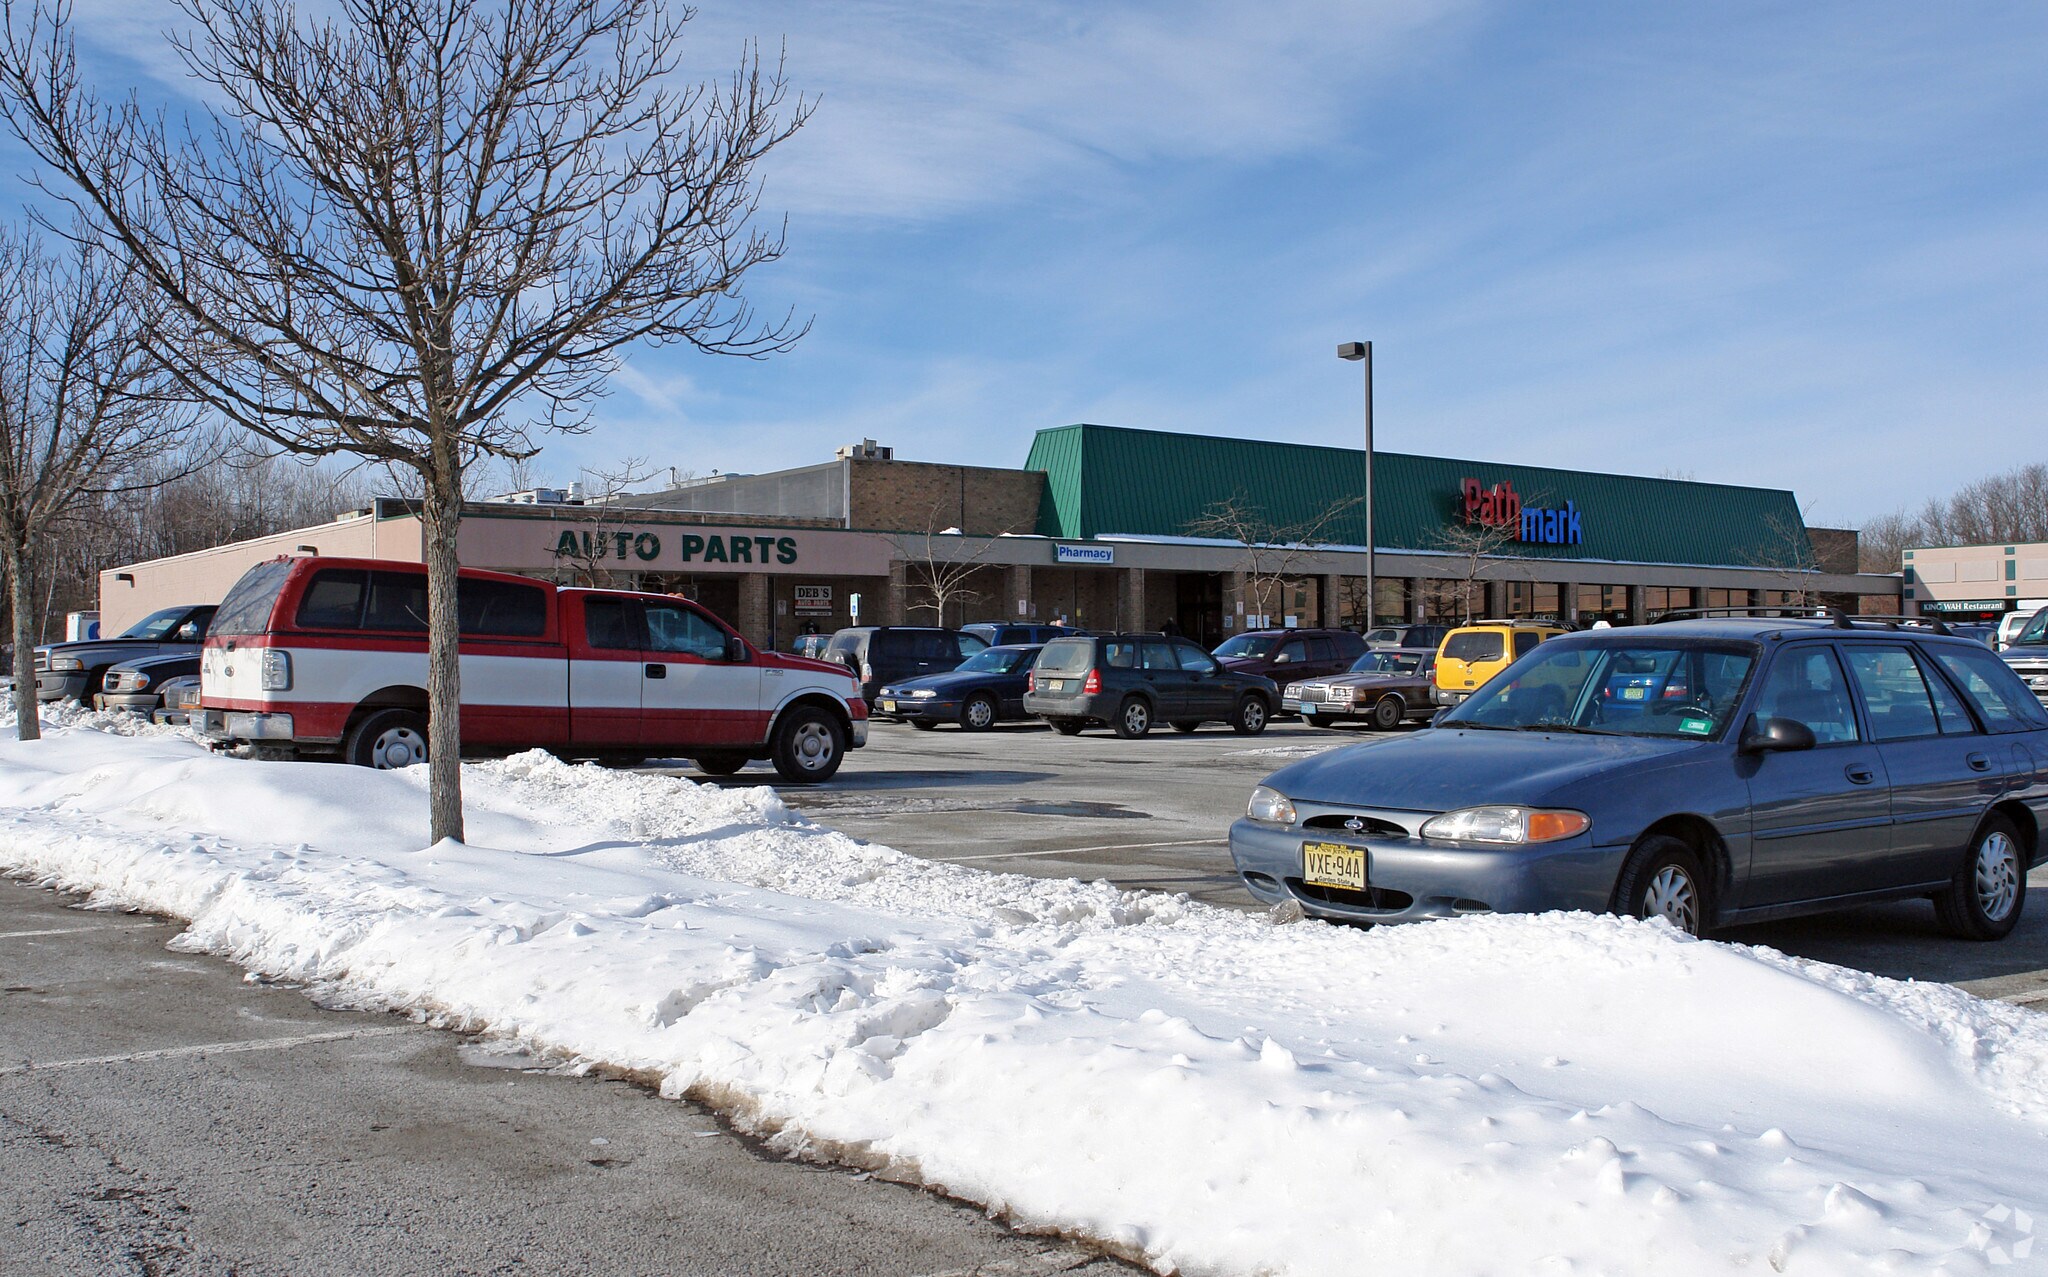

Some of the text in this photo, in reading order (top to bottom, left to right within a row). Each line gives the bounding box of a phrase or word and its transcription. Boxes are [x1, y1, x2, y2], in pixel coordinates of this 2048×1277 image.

[557, 530, 798, 564] AUTO PARTS
[1059, 546, 1112, 561] Pharmacy
[798, 587, 830, 598] DEB'S
[1923, 601, 2003, 611] KING WAH Restaurant
